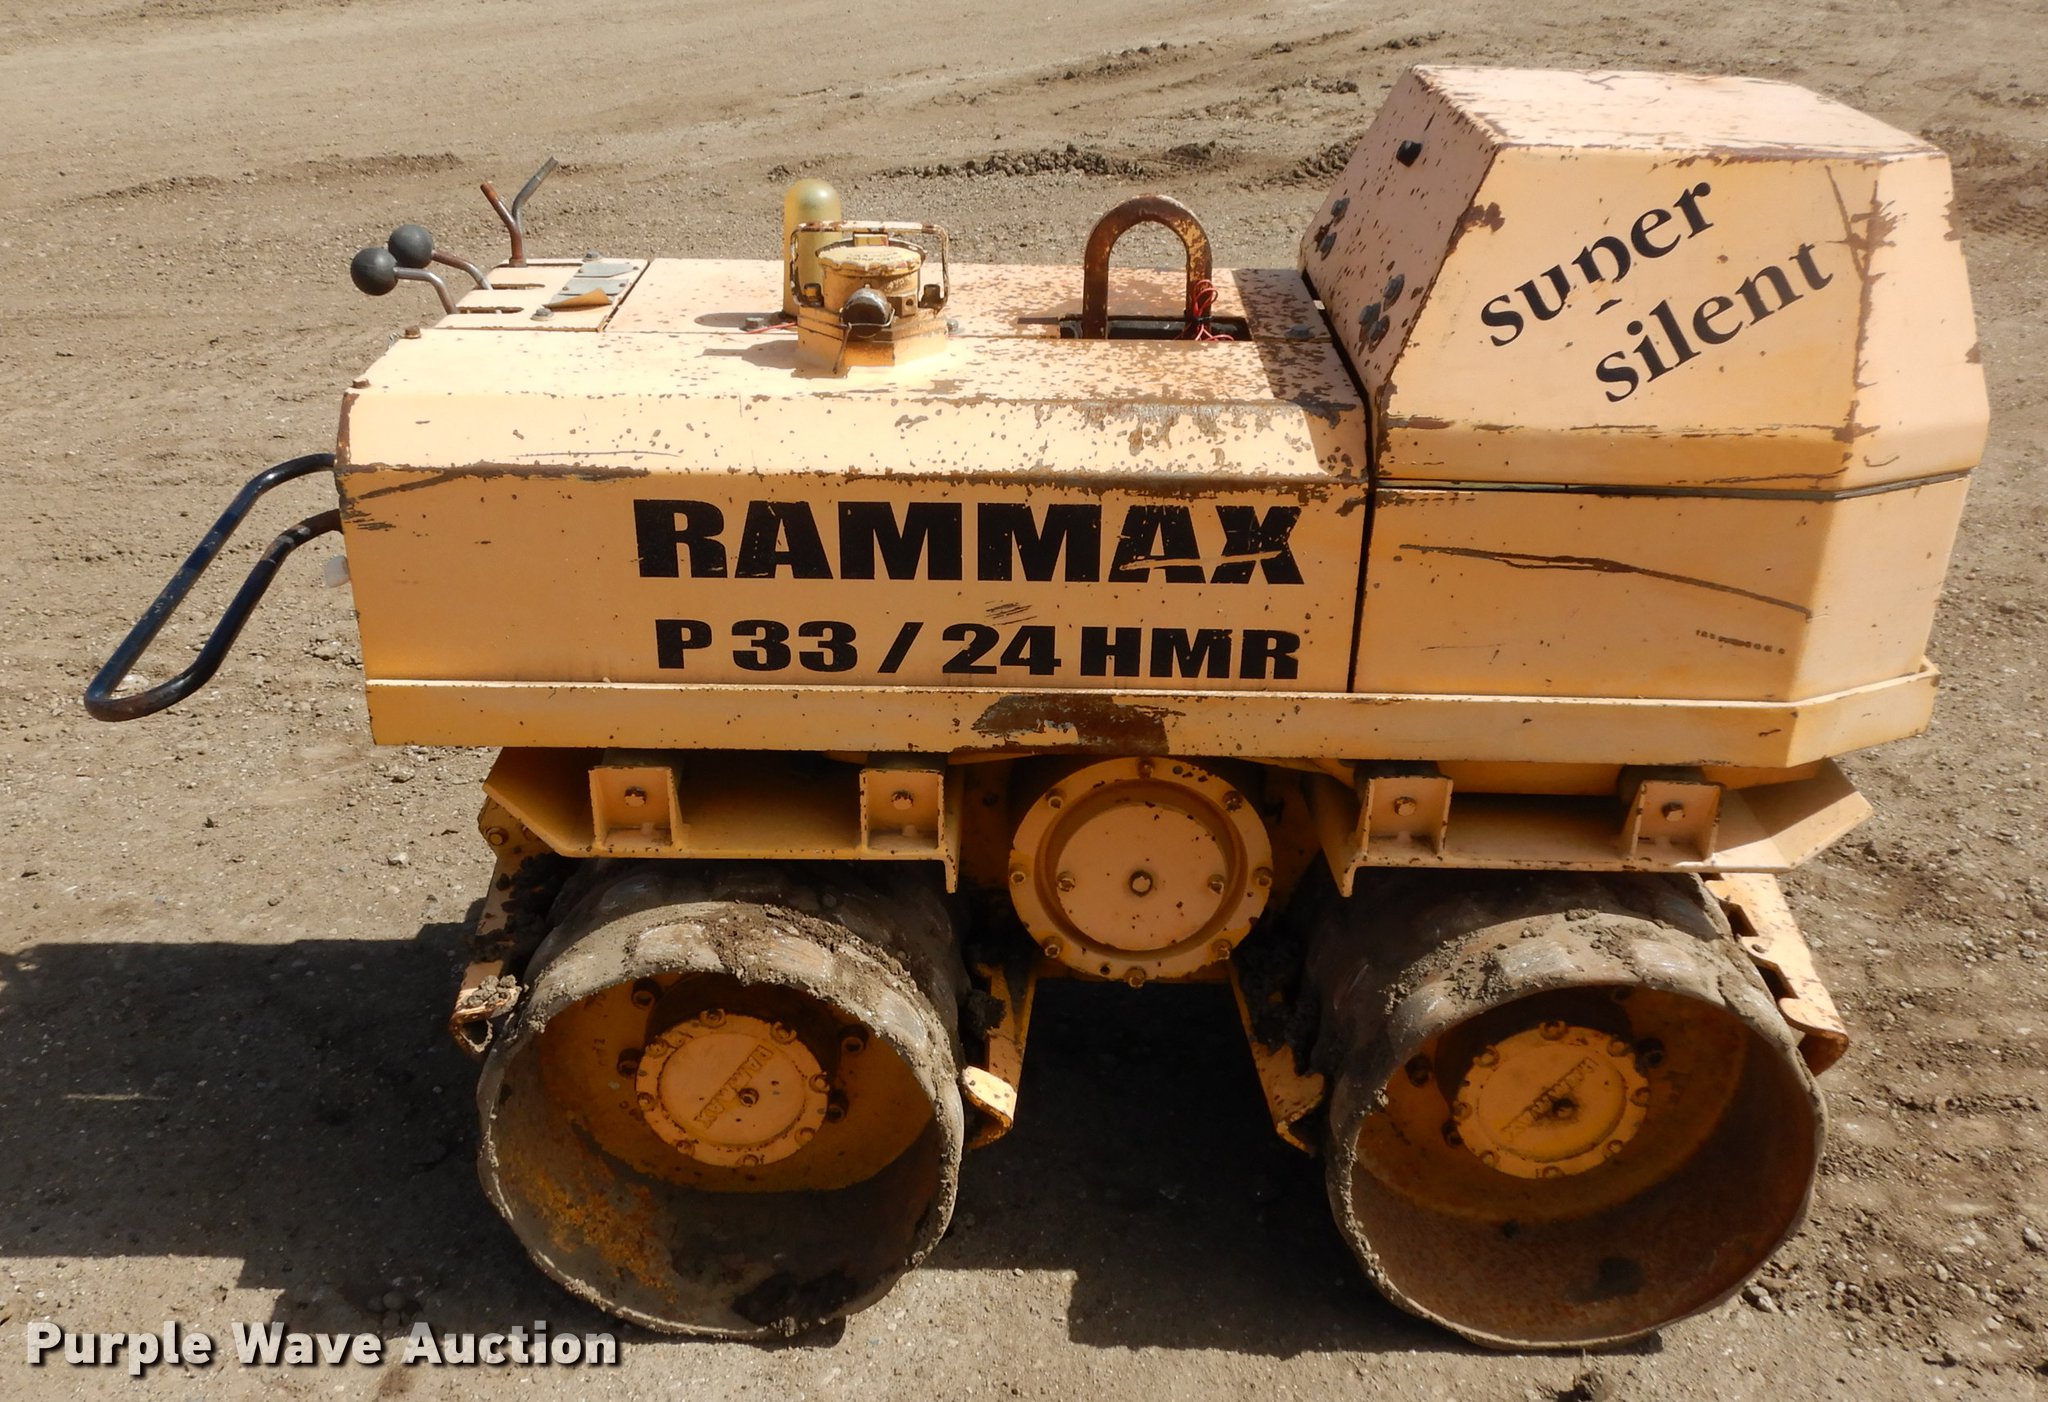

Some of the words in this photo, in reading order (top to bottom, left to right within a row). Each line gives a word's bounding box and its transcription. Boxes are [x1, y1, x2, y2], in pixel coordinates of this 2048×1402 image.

[1480, 181, 1715, 347] super
[1595, 242, 1834, 403] silent
[633, 499, 1305, 585] RAMMAX
[1080, 626, 1301, 680] HMR
